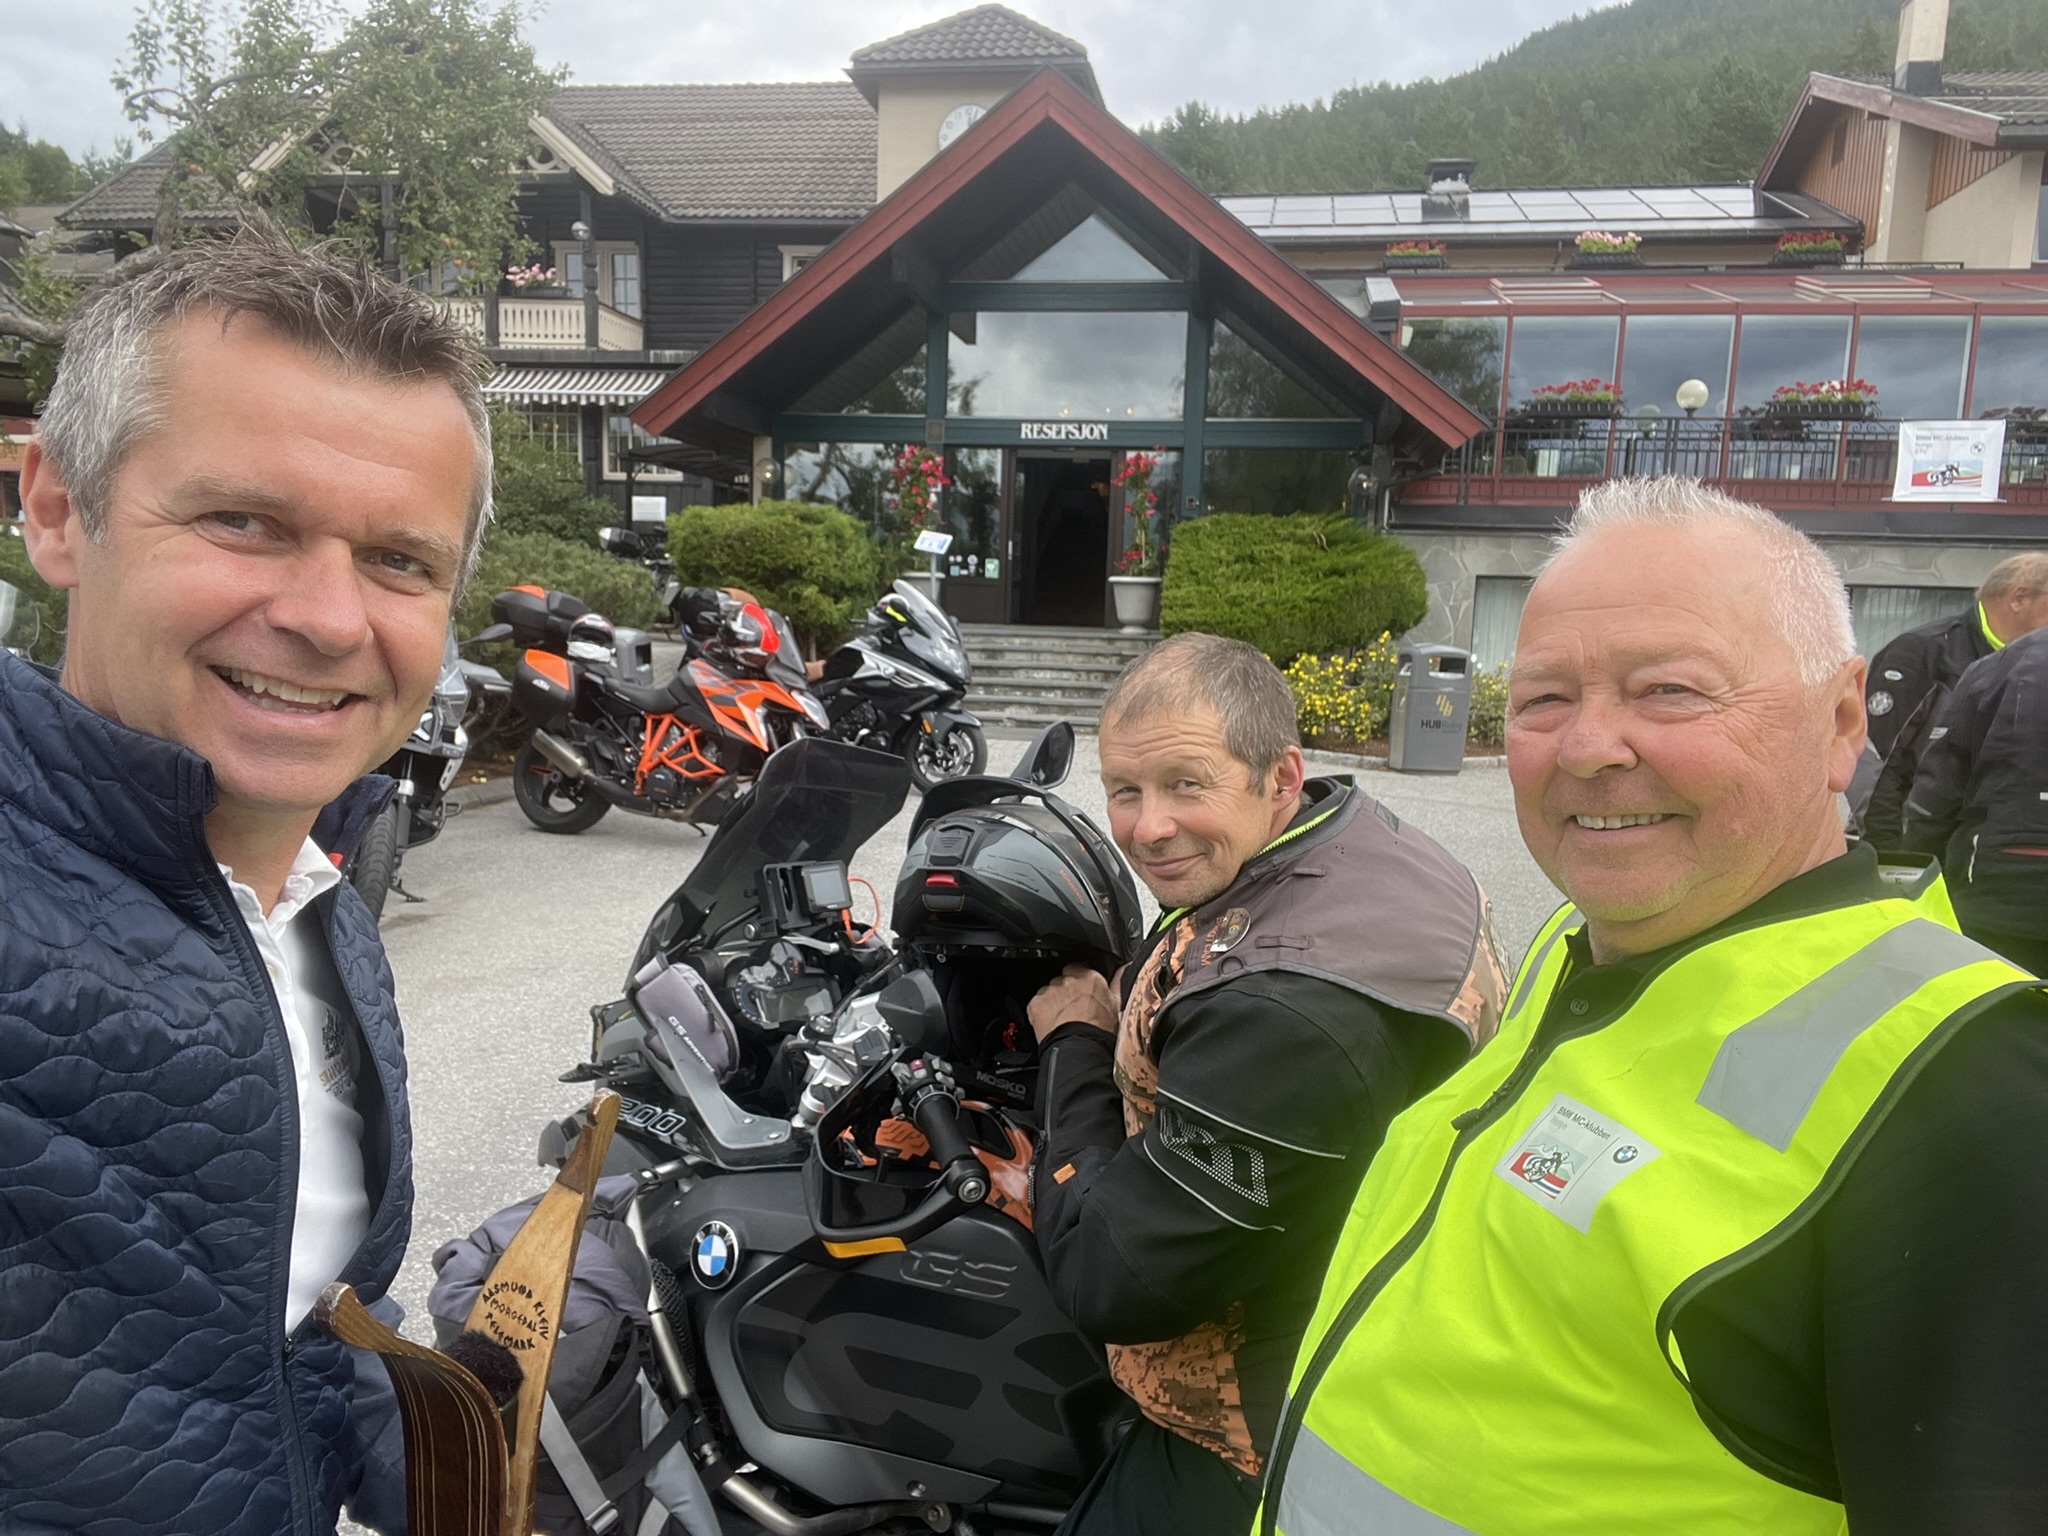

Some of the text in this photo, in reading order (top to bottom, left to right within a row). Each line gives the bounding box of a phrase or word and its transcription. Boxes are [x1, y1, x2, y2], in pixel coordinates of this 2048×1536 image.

[1020, 423, 1108, 440] RESEPSJON
[668, 1015, 687, 1036] GS
[976, 1070, 1026, 1095] MOSKO
[1557, 1105, 1612, 1142] BMW MC-klubben
[900, 1250, 1019, 1299] GS
[482, 1281, 534, 1305] AASMUND
